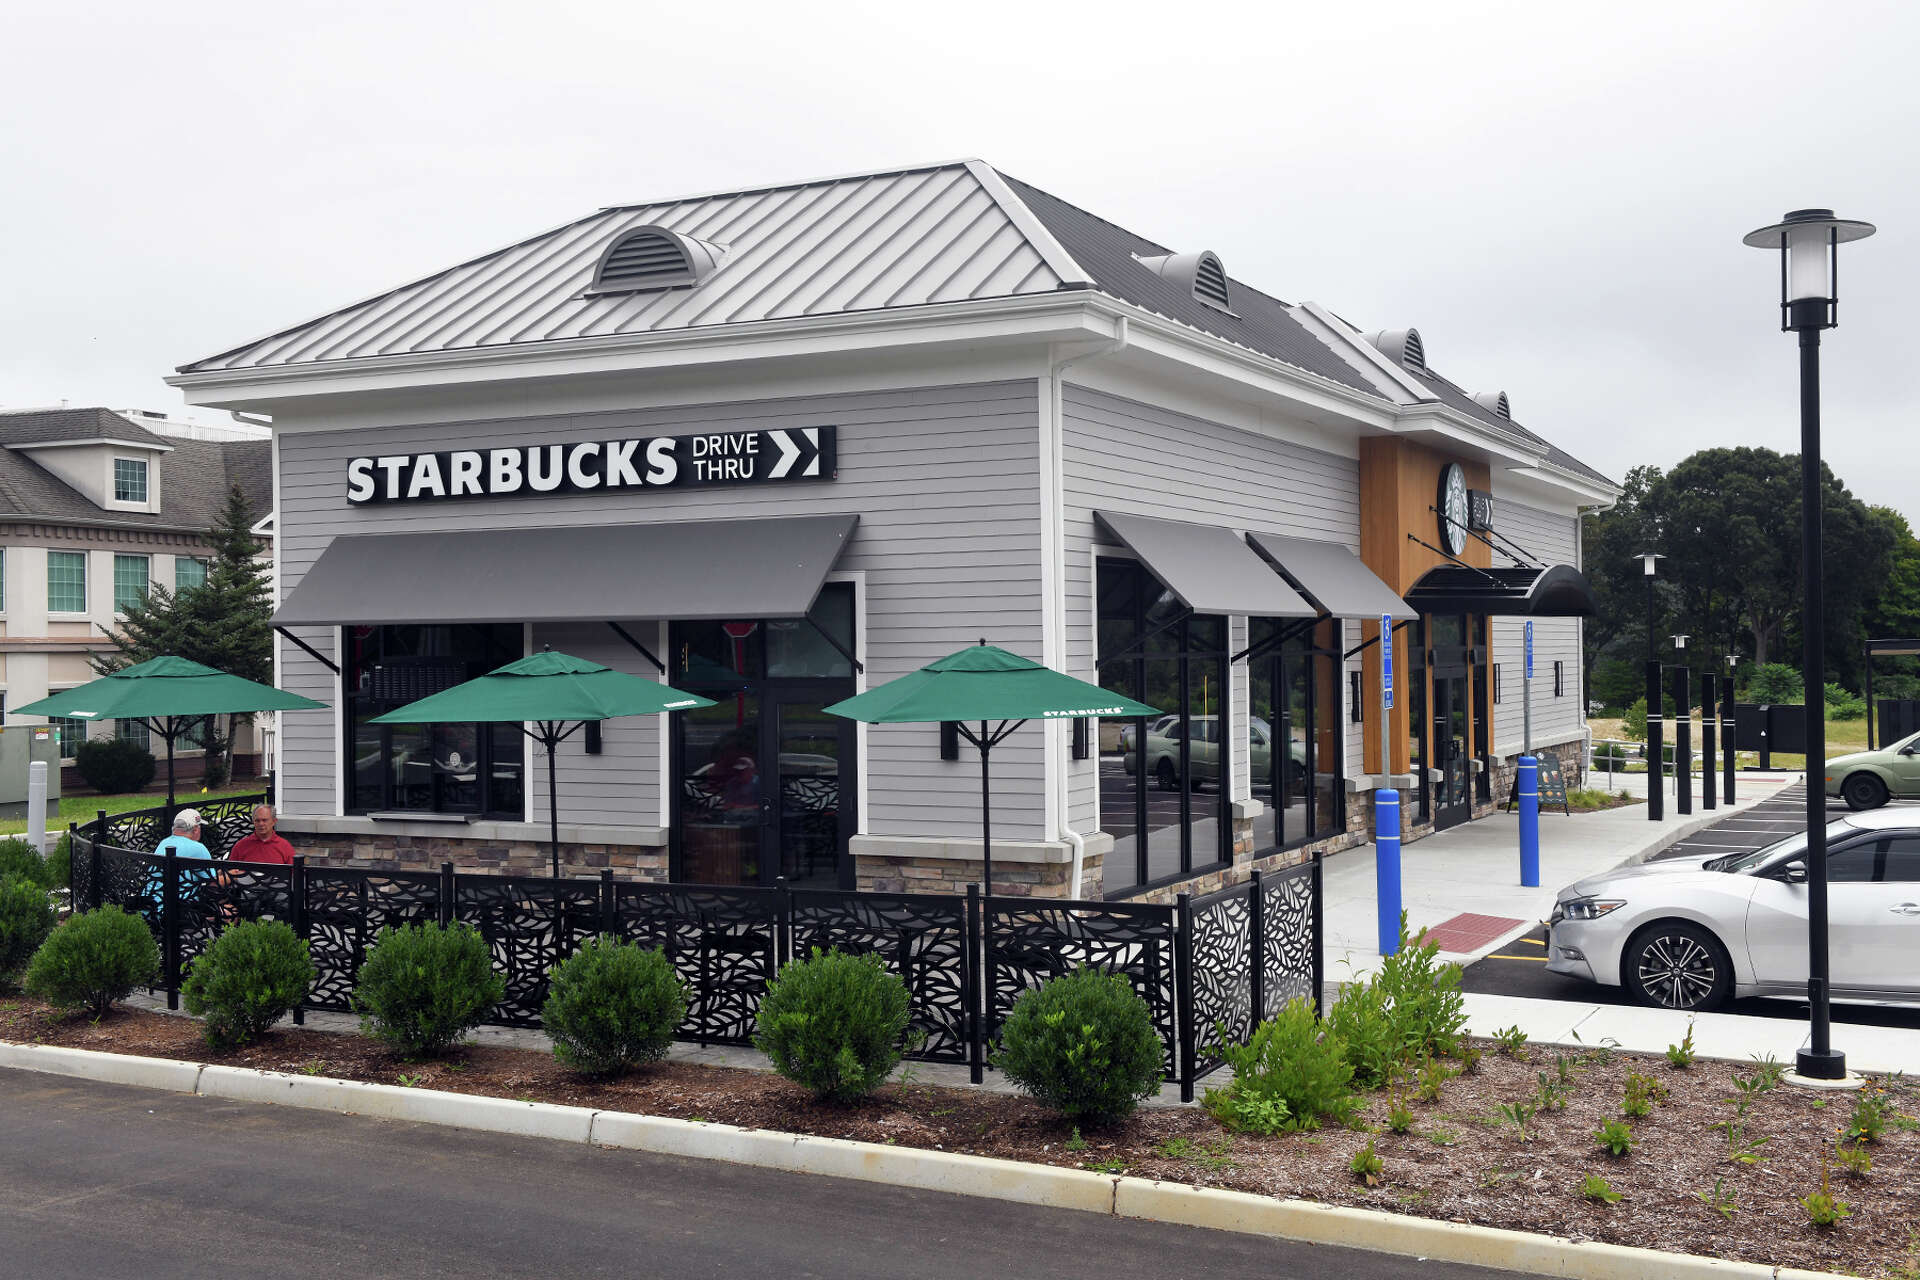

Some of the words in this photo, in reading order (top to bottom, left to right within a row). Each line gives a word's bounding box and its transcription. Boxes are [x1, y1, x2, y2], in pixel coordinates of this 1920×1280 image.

[692, 432, 759, 457] DRIVE
[347, 437, 679, 502] STARBUCKS
[692, 457, 754, 481] THRU
[1043, 706, 1124, 717] STARBUCKS
